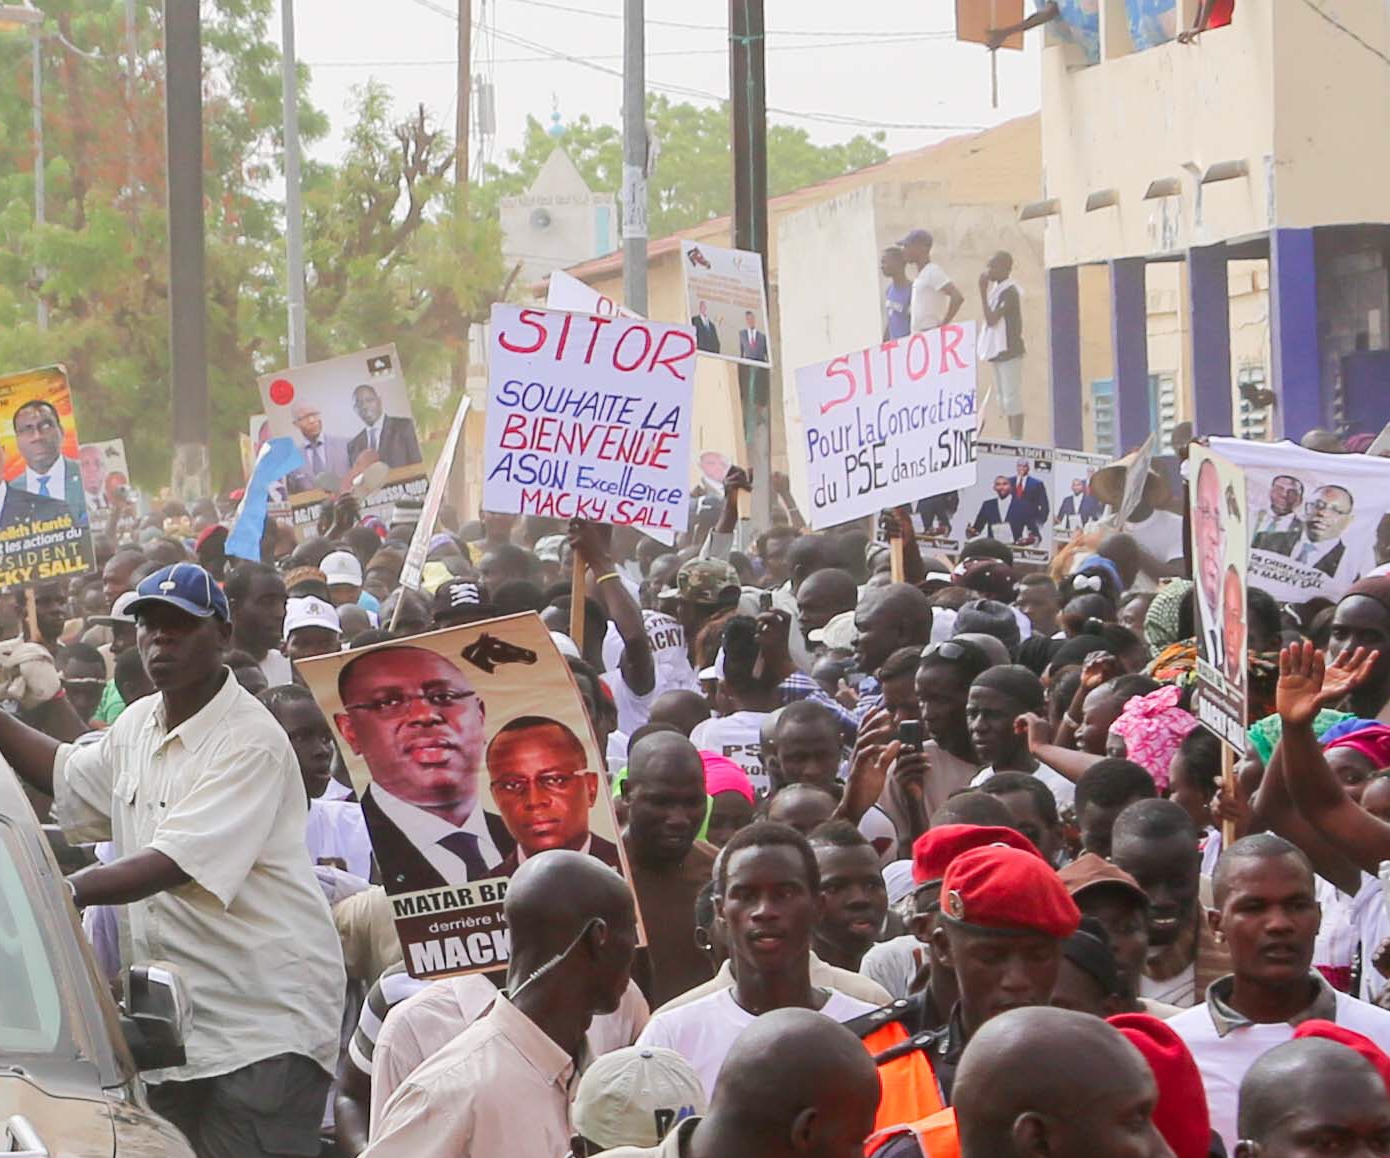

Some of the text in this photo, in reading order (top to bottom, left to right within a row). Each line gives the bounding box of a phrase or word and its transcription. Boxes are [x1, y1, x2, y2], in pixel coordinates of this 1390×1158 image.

[498, 309, 697, 381] SITOR
[821, 323, 970, 415] SITOR
[496, 380, 681, 433] SOUHAITE LA
[500, 414, 680, 469] BIENVENUE
[807, 424, 852, 463] Pour
[576, 465, 682, 505] Excellence
[814, 473, 837, 508] du
[844, 442, 888, 498] PSE
[892, 448, 927, 482] dans
[938, 428, 977, 470] SINE
[31, 513, 72, 534] Kanté
[521, 488, 673, 528] MACKY SALL
[23, 531, 65, 548] actions
[65, 526, 82, 539] du
[39, 556, 89, 580] SALL
[393, 888, 474, 917] MATAR
[429, 915, 492, 933] derrière
[408, 928, 510, 974] MACK
